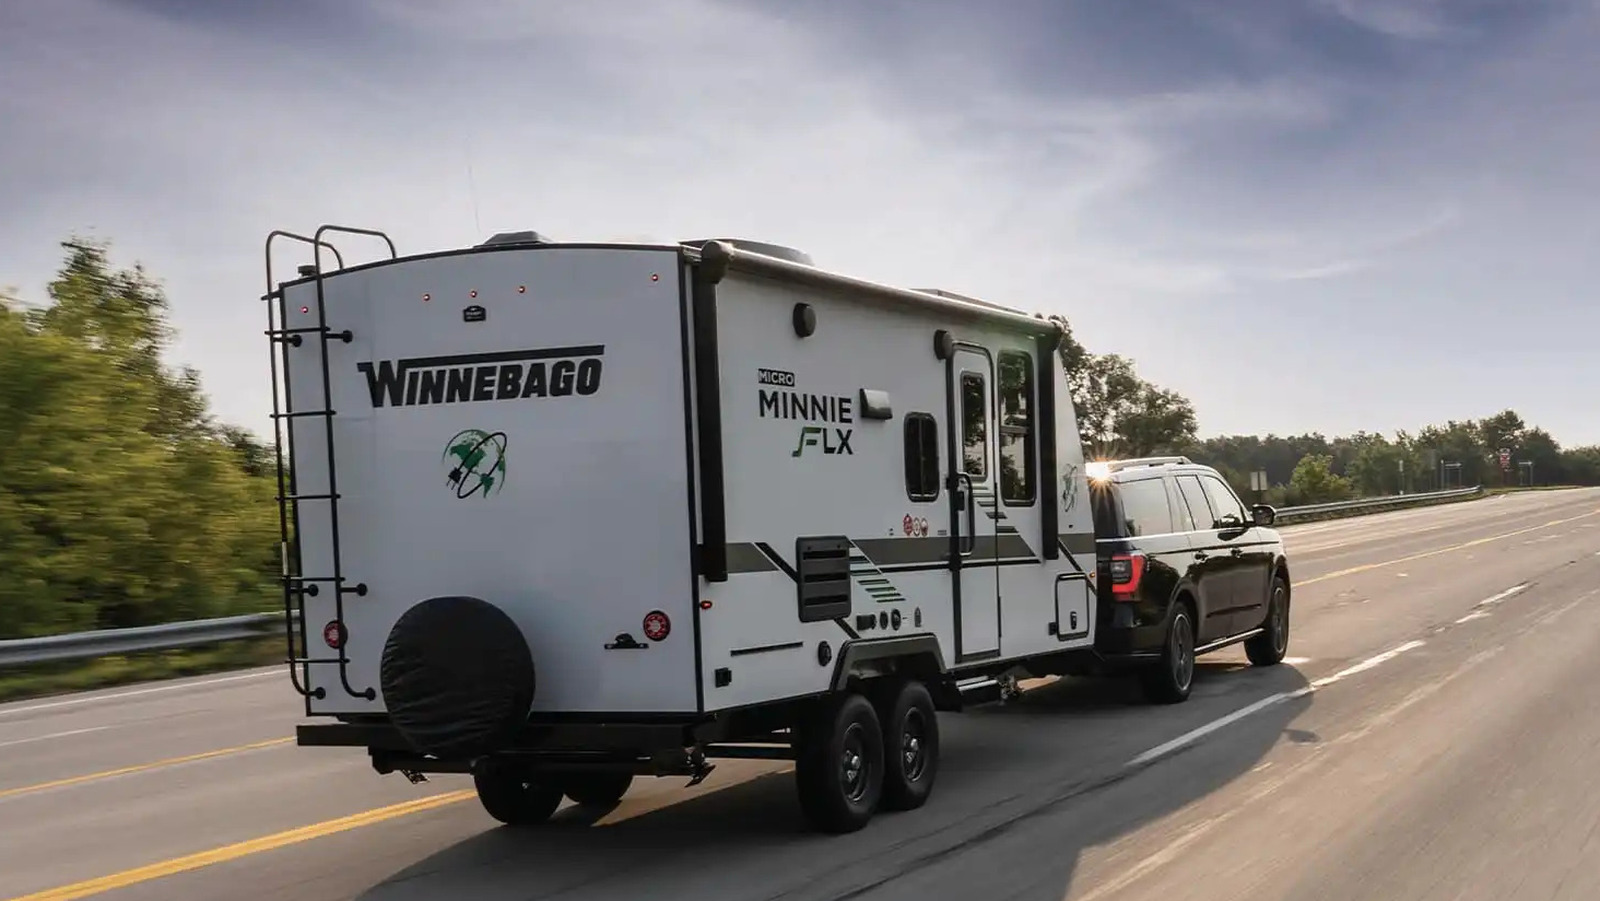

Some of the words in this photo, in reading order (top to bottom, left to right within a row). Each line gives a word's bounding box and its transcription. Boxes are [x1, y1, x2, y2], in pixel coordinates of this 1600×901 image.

[357, 345, 604, 408] WINNEBAGO
[758, 369, 795, 386] MICRO
[759, 389, 853, 424] MINNIE
